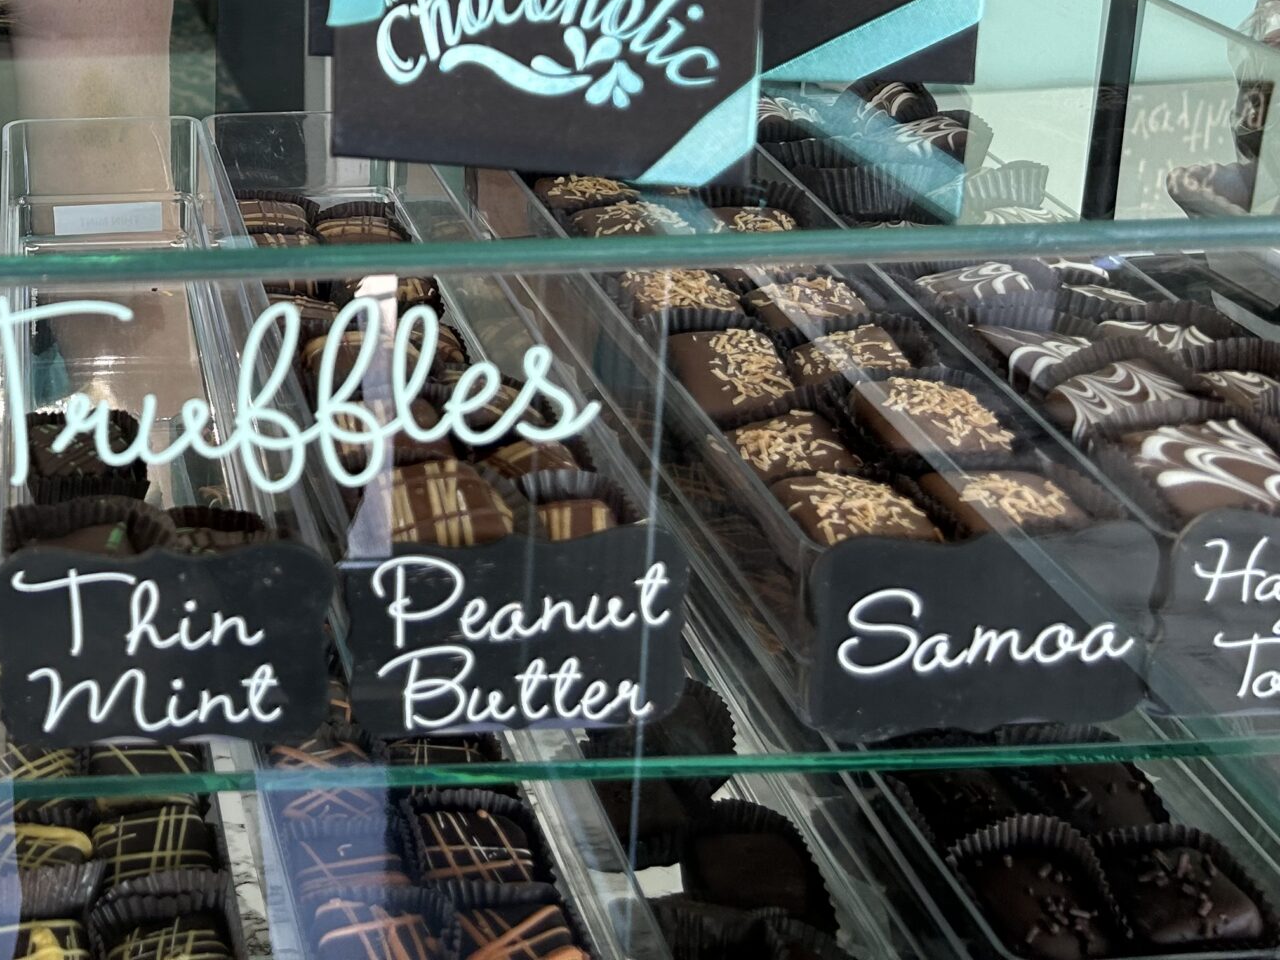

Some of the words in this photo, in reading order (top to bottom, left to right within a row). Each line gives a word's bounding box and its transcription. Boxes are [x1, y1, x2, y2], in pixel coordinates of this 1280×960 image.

[11, 566, 264, 658] Thin
[370, 553, 674, 649] Peanut
[837, 587, 1135, 676] Samoa
[27, 663, 283, 734] Mint
[376, 644, 655, 730] Butter
